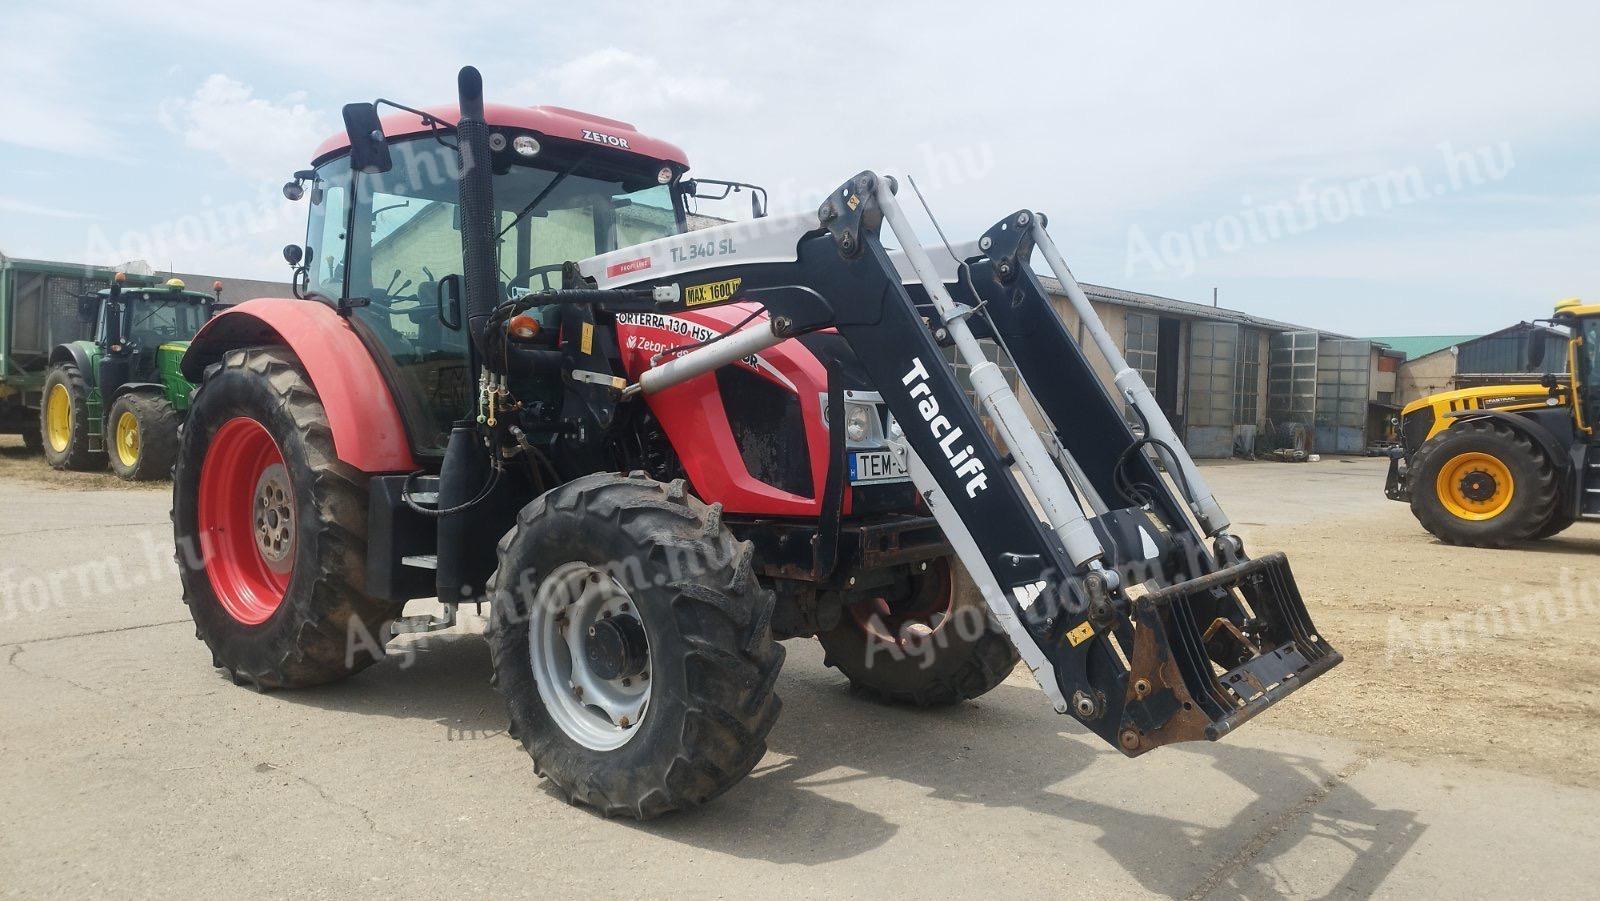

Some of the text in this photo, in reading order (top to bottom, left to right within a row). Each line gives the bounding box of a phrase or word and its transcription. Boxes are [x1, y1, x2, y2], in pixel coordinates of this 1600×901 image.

[582, 130, 629, 149] ZETOR
[670, 238, 737, 263] TL 340 SL
[688, 286, 707, 303] MAX:
[710, 282, 731, 299] 1600
[617, 312, 665, 329] ORTERRA
[669, 318, 688, 334] 130
[902, 357, 987, 498] TracLift
